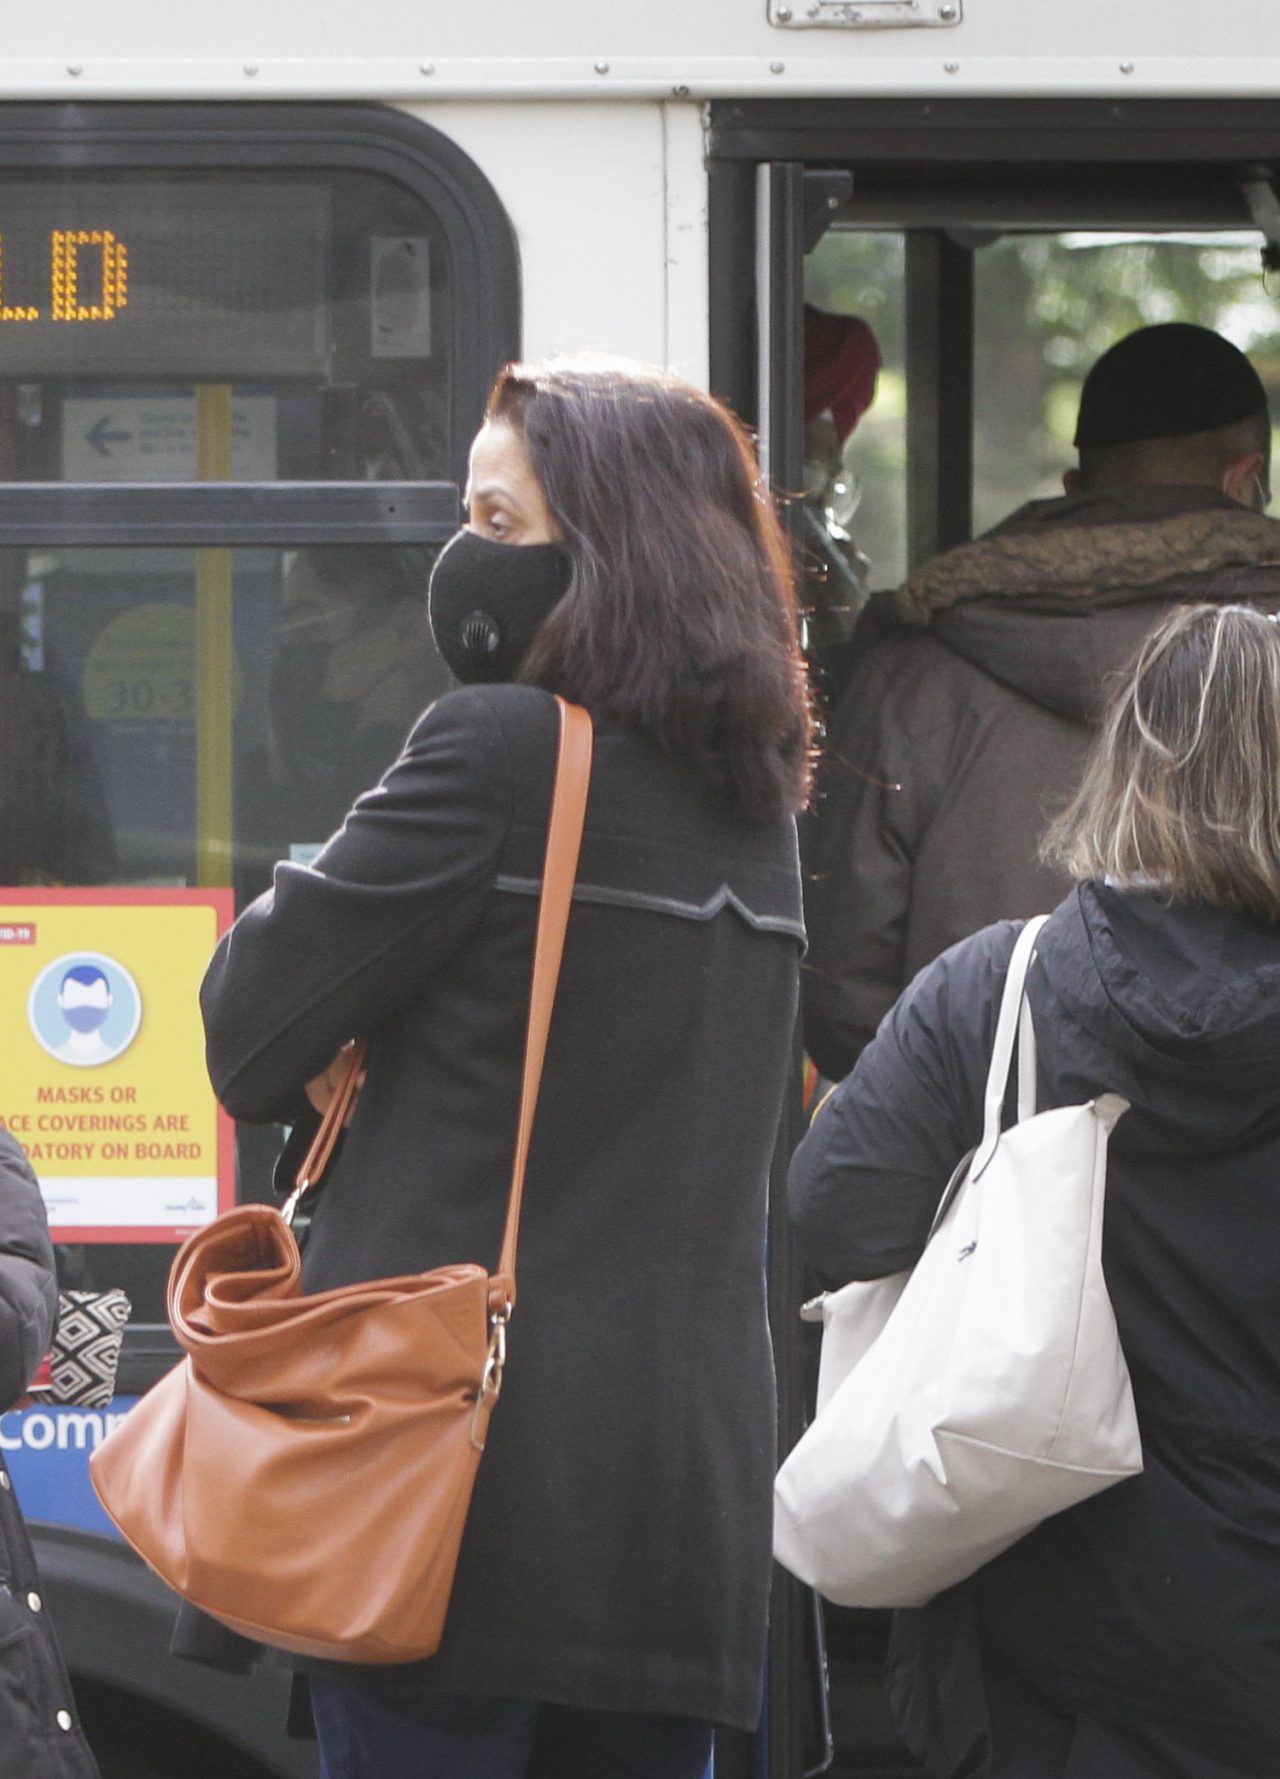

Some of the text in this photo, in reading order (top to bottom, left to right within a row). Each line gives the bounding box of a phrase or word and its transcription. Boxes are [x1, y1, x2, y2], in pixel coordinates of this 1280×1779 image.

[106, 677, 195, 713] 30-3
[37, 1086, 137, 1104] MASKS OR
[37, 1114, 147, 1132] COVERINGS
[153, 1114, 190, 1132] ARE
[101, 1142, 130, 1160] ON
[136, 1142, 202, 1160] BOARD
